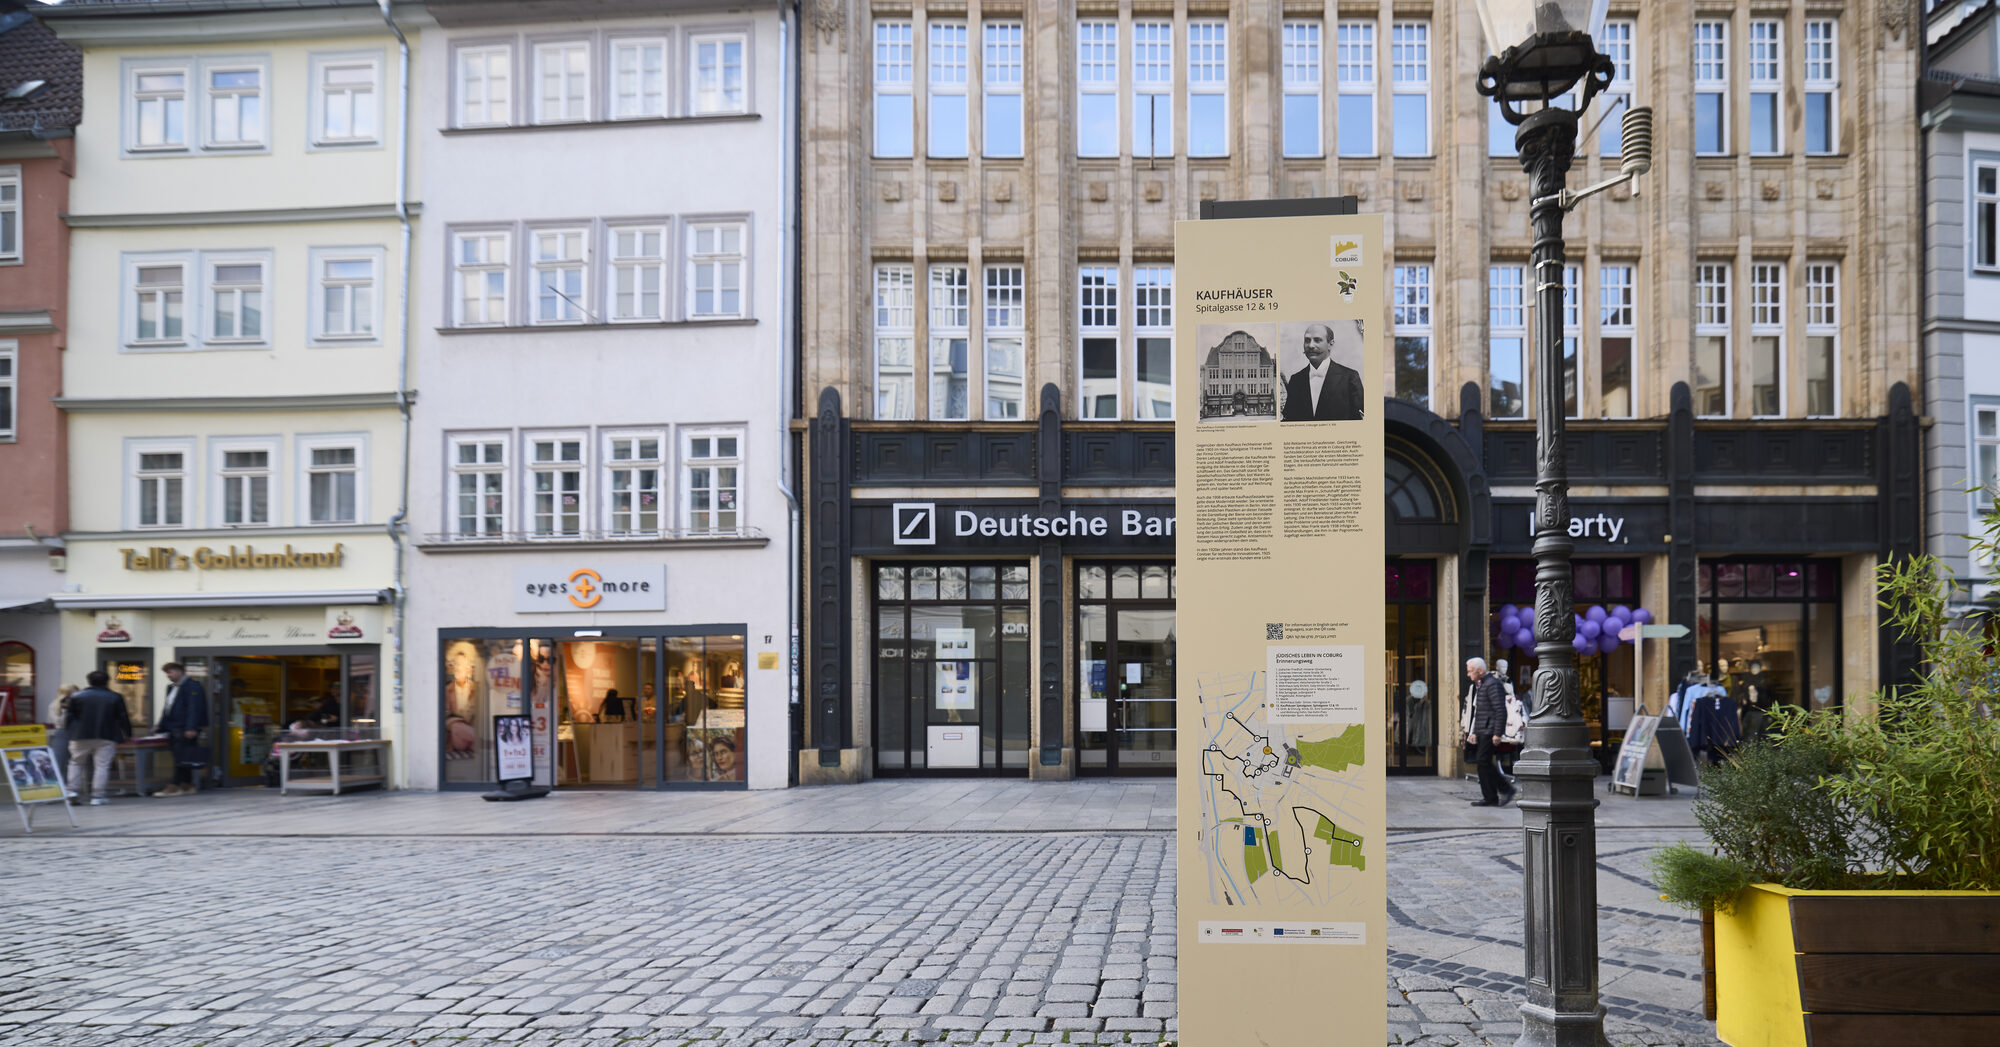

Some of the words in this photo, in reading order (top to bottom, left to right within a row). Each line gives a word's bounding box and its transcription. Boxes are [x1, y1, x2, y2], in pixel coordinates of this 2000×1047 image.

[1196, 288, 1273, 300] KAUFHÄUSER
[1196, 304, 1243, 314] Spitalgasse
[955, 510, 1108, 536] Deutsche
[1122, 510, 1176, 536] Ban
[1530, 512, 1624, 542] lerty
[119, 547, 189, 571] Telli's
[194, 542, 344, 569] Goldankauf
[526, 583, 568, 597] eyes
[602, 581, 650, 592] more
